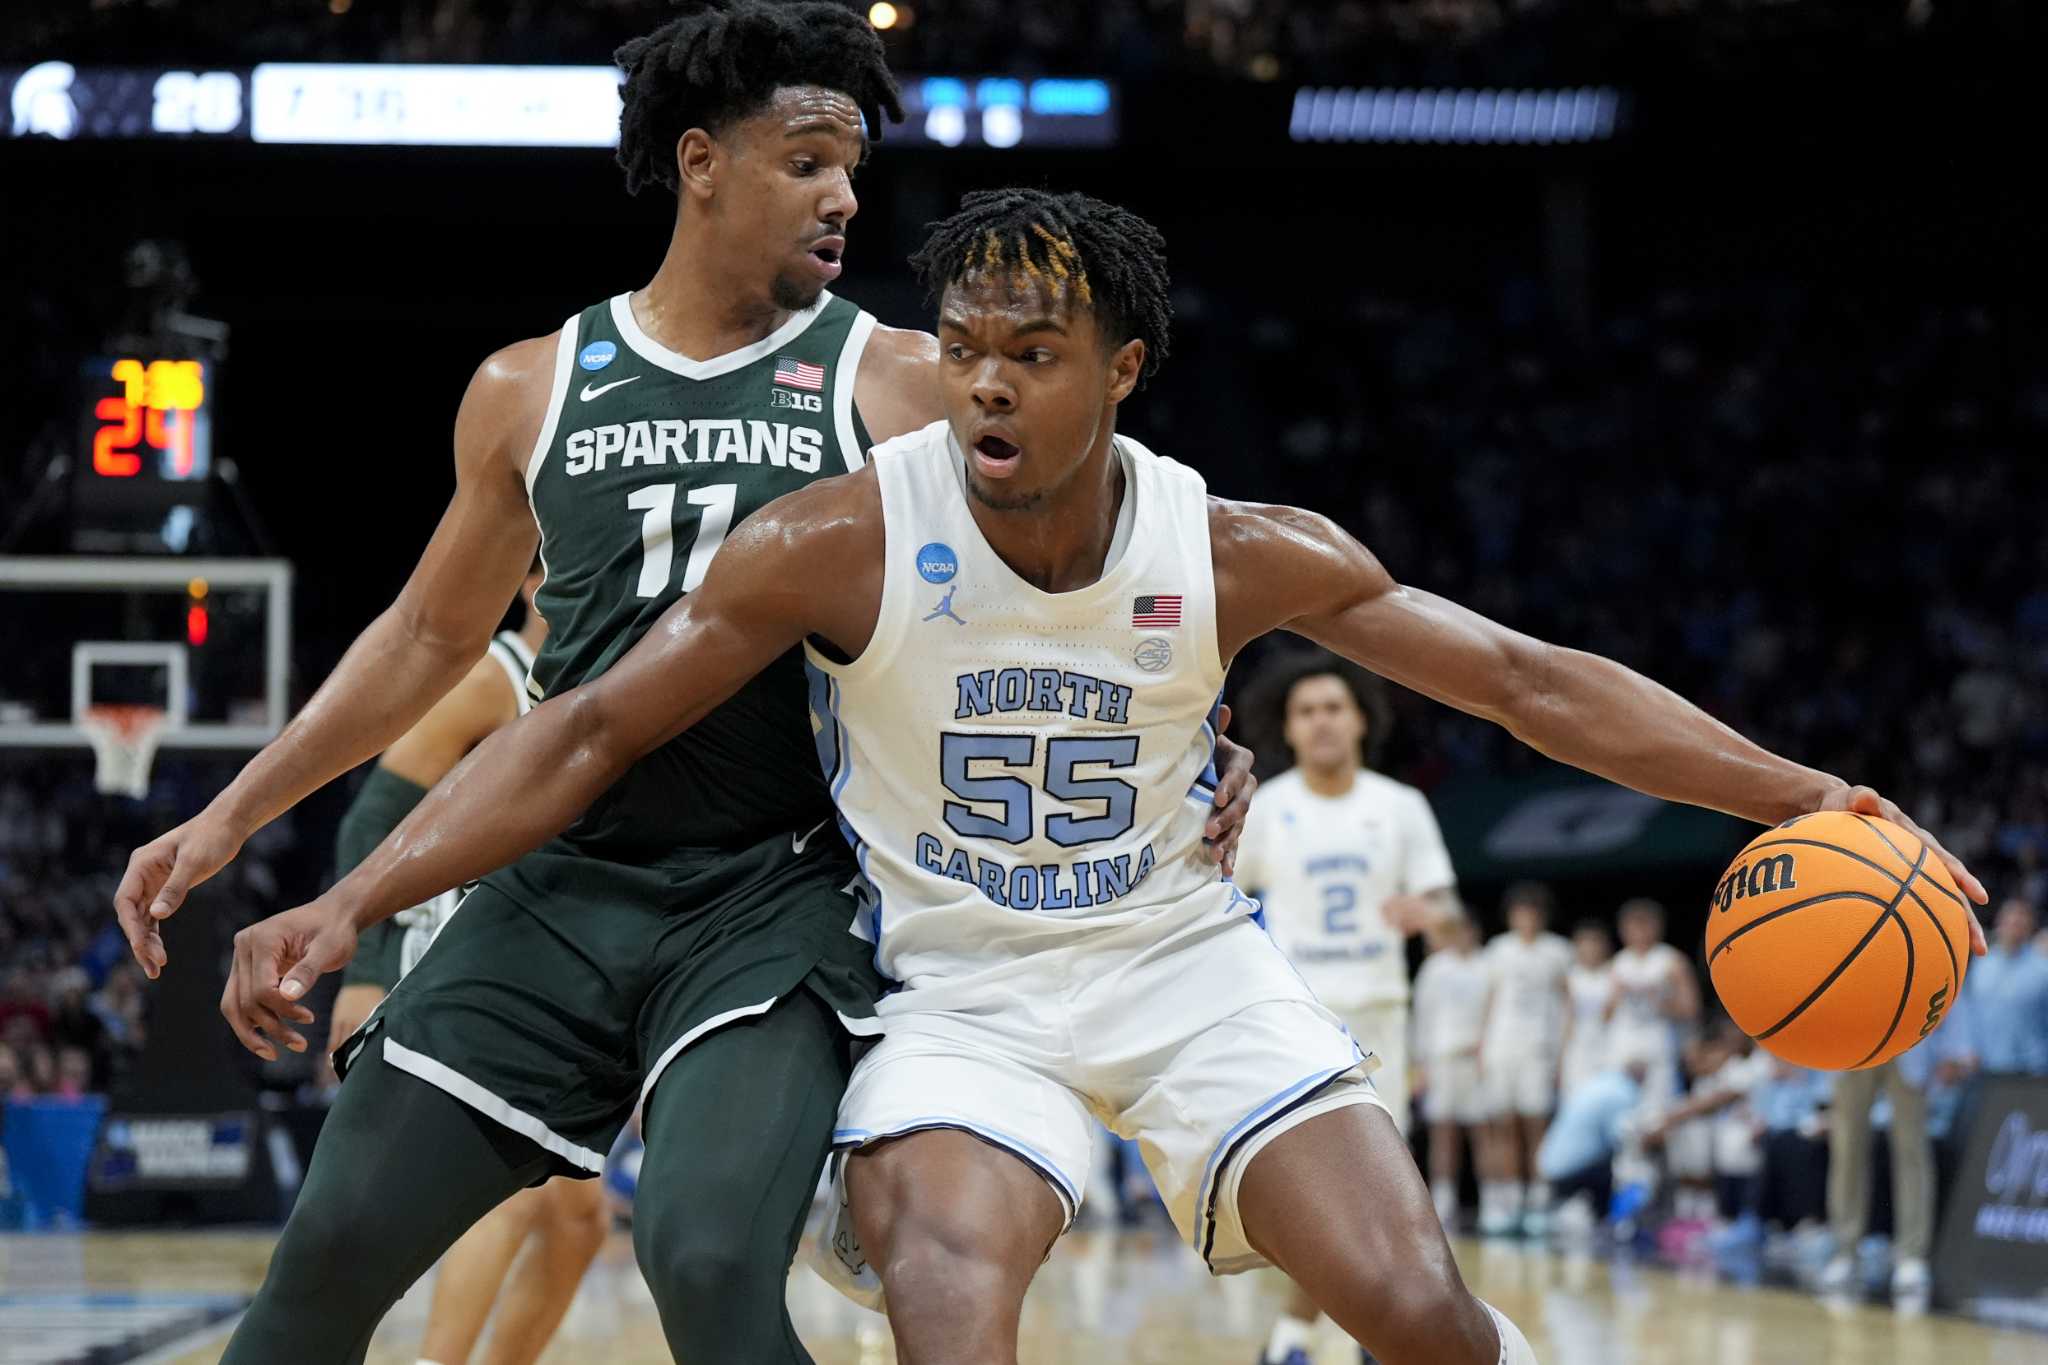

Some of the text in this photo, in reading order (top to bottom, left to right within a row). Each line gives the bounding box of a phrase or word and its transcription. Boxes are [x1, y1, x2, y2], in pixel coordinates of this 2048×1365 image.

[565, 419, 823, 477] SPARTANS
[627, 484, 738, 598] 11
[922, 561, 954, 574] NCAA
[954, 667, 1133, 724] NORTH
[940, 731, 1140, 848] 55
[916, 832, 1156, 910] CAROLINA
[1713, 853, 1797, 913] Wil
[1321, 883, 1358, 934] 2
